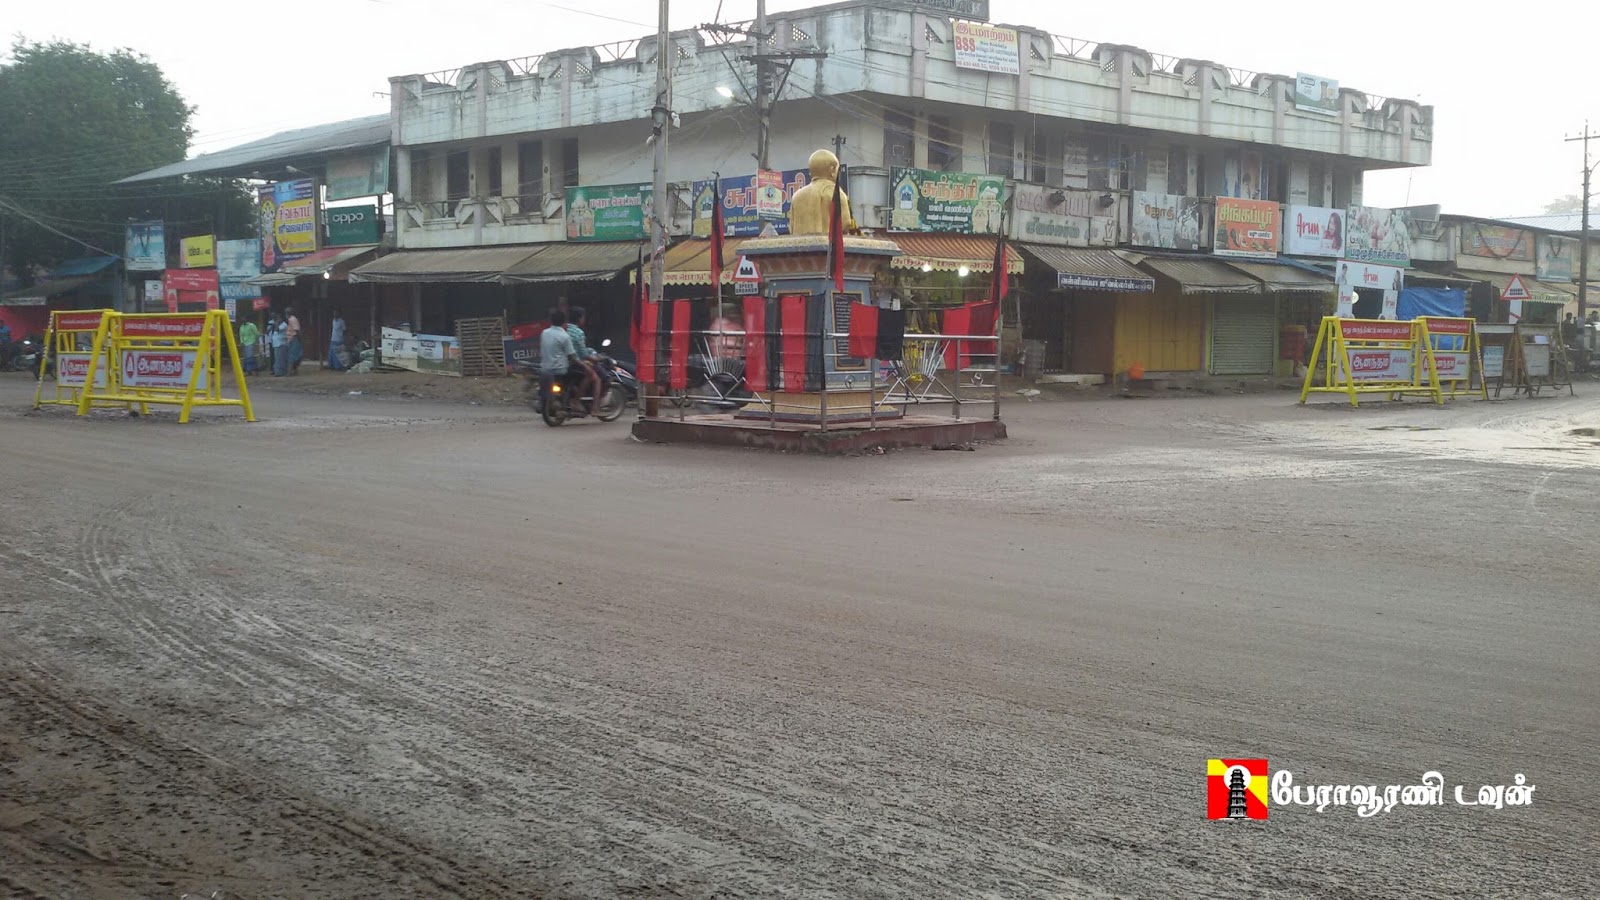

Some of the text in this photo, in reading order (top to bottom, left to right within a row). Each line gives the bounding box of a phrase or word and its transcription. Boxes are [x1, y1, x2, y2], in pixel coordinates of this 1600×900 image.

[956, 23, 1014, 42] இடமாற்றம்
[955, 36, 975, 52] BSS
[921, 174, 978, 204] சுந்தரி
[928, 204, 943, 212] மலர்
[1220, 203, 1274, 230] சிங்கப்பூர்
[1296, 212, 1319, 238] Arun
[1350, 248, 1408, 261] பழமுதிர்ச்சோலை
[1363, 267, 1378, 283] Arun
[221, 285, 253, 297] NOKIA
[138, 357, 182, 374] ஆனந்தம்
[1353, 355, 1389, 370] ஆனந்தம்
